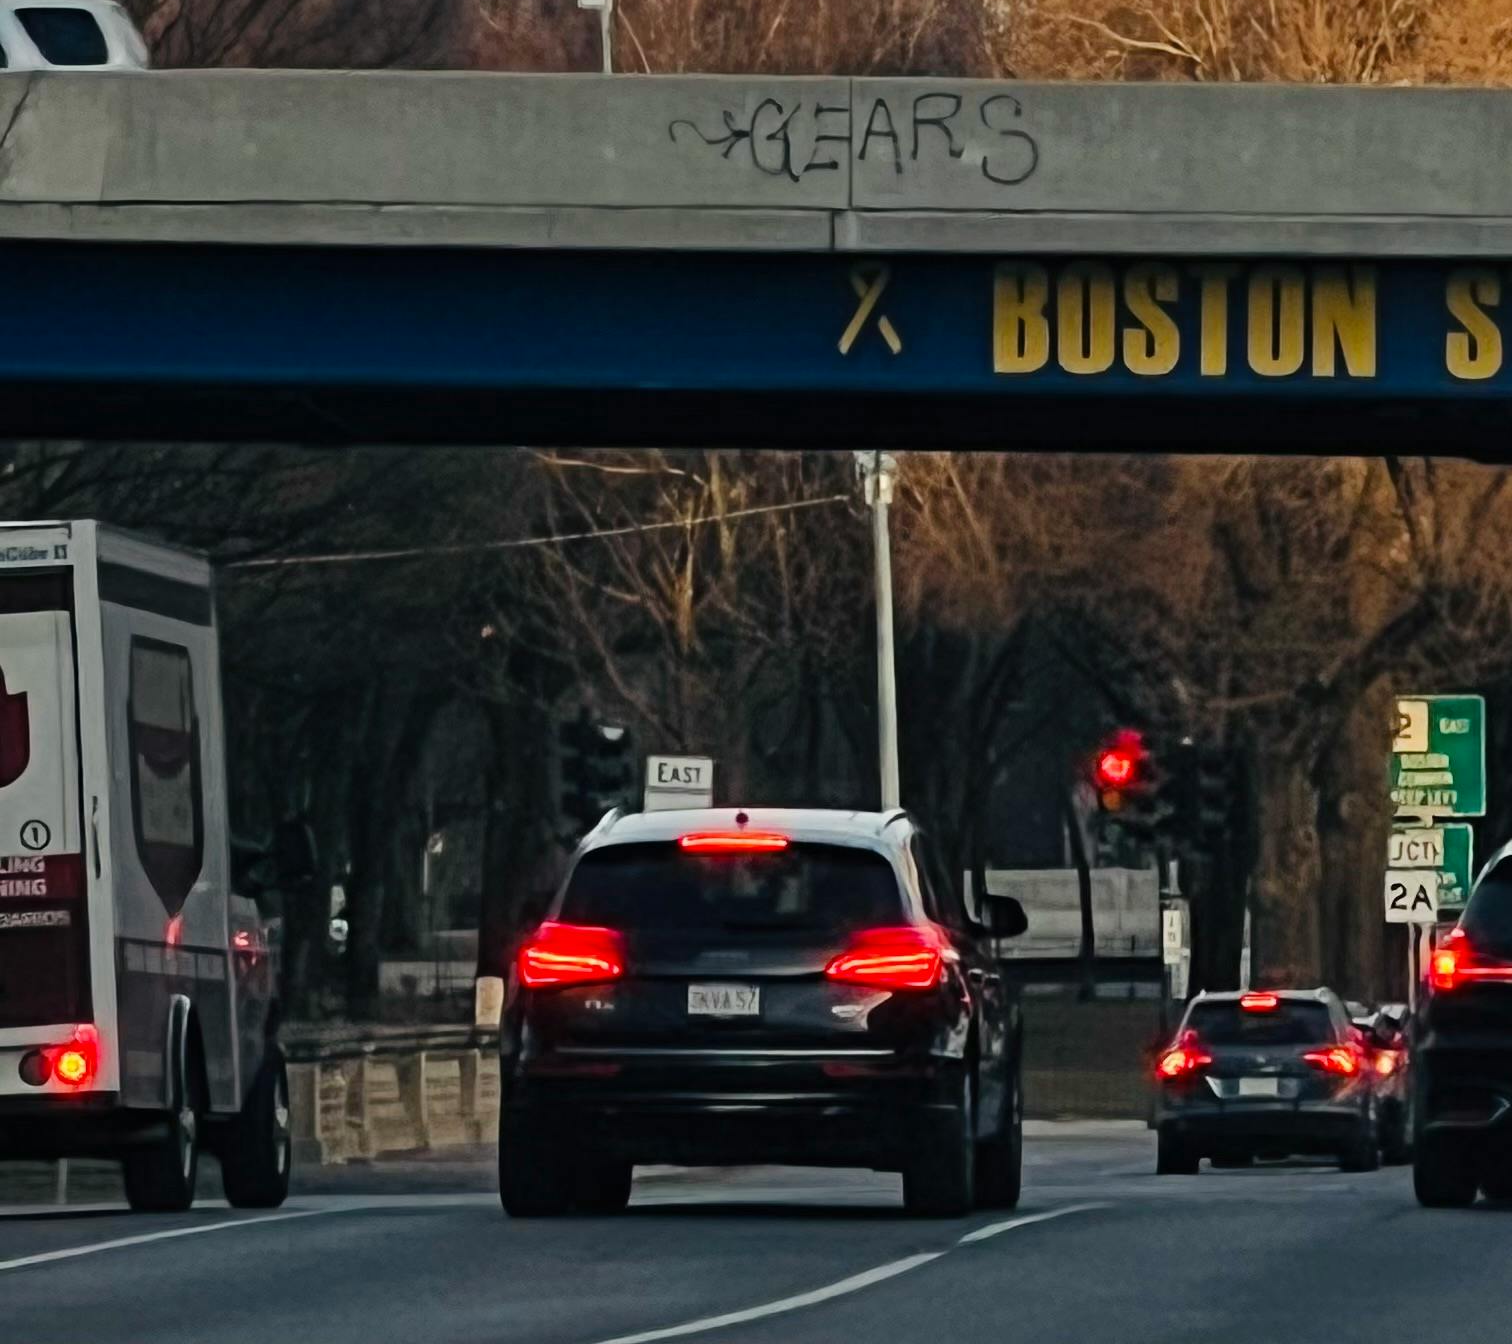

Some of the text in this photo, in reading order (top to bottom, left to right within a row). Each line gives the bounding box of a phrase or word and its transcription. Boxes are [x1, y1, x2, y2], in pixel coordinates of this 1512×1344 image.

[993, 261, 1376, 377] BOSTON
[658, 762, 701, 783] EAST
[1391, 840, 1434, 862] JCT
[1390, 882, 1433, 911] 2A
